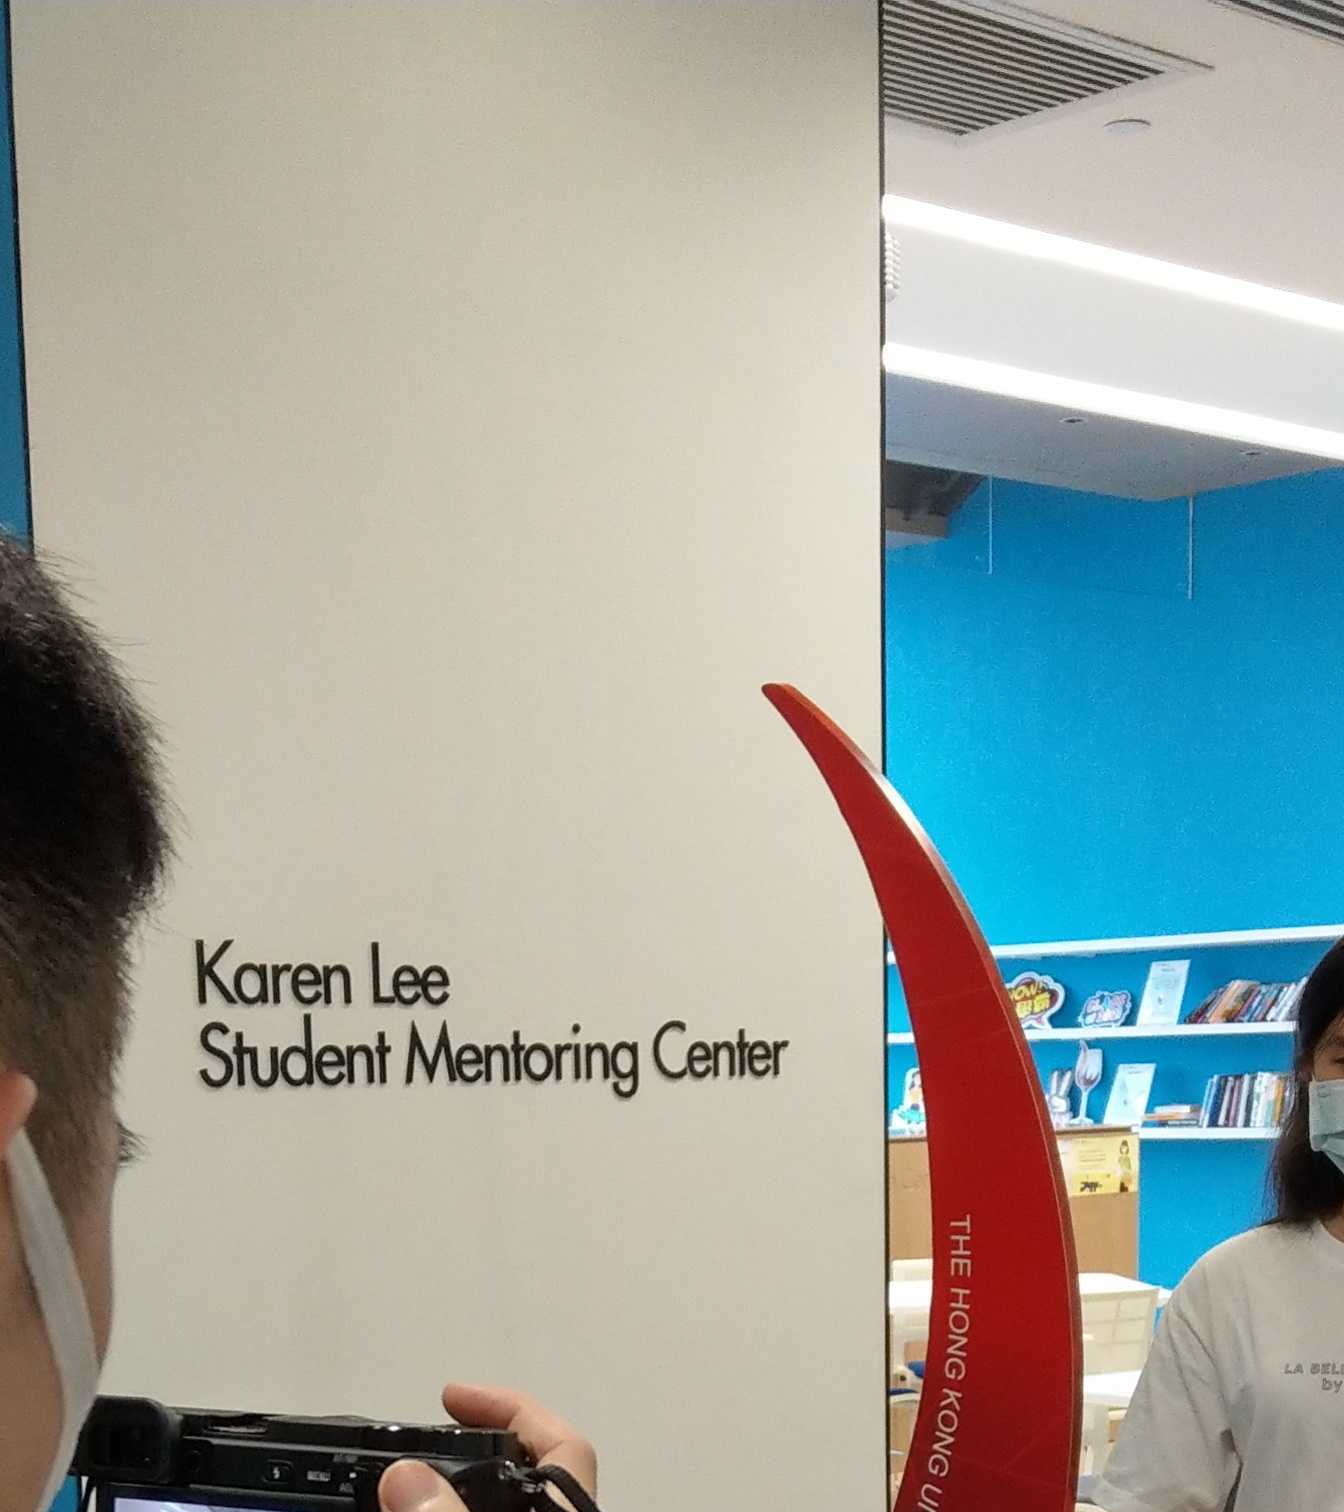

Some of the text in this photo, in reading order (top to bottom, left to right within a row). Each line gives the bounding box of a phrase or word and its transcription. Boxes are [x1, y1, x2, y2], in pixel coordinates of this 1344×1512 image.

[195, 939, 450, 1005] Karen Lee
[199, 1013, 789, 1098] Student Mentoring Center
[949, 1213, 972, 1278] THE
[943, 1287, 971, 1381] HONG
[1283, 1363, 1305, 1375] LA
[1321, 1377, 1344, 1393] by
[928, 1387, 963, 1478] KONG
